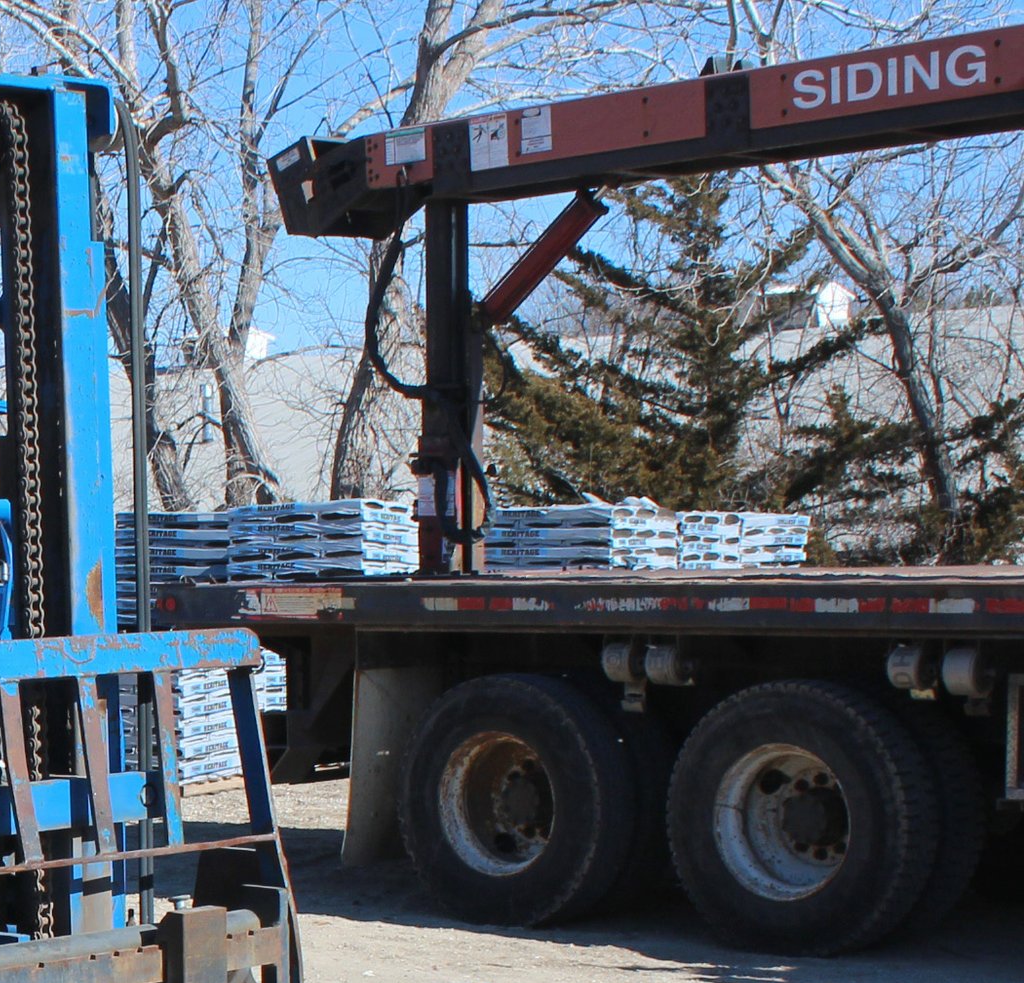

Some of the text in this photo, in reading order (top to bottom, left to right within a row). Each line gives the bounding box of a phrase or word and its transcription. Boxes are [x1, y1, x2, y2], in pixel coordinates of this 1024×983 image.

[792, 45, 986, 109] SIDING
[203, 680, 227, 690] HERITAGE
[204, 701, 227, 711] HERITAGE
[204, 721, 228, 732] HERITAGE
[205, 741, 229, 752] HERITAGE
[204, 760, 228, 770] HERITAGE
